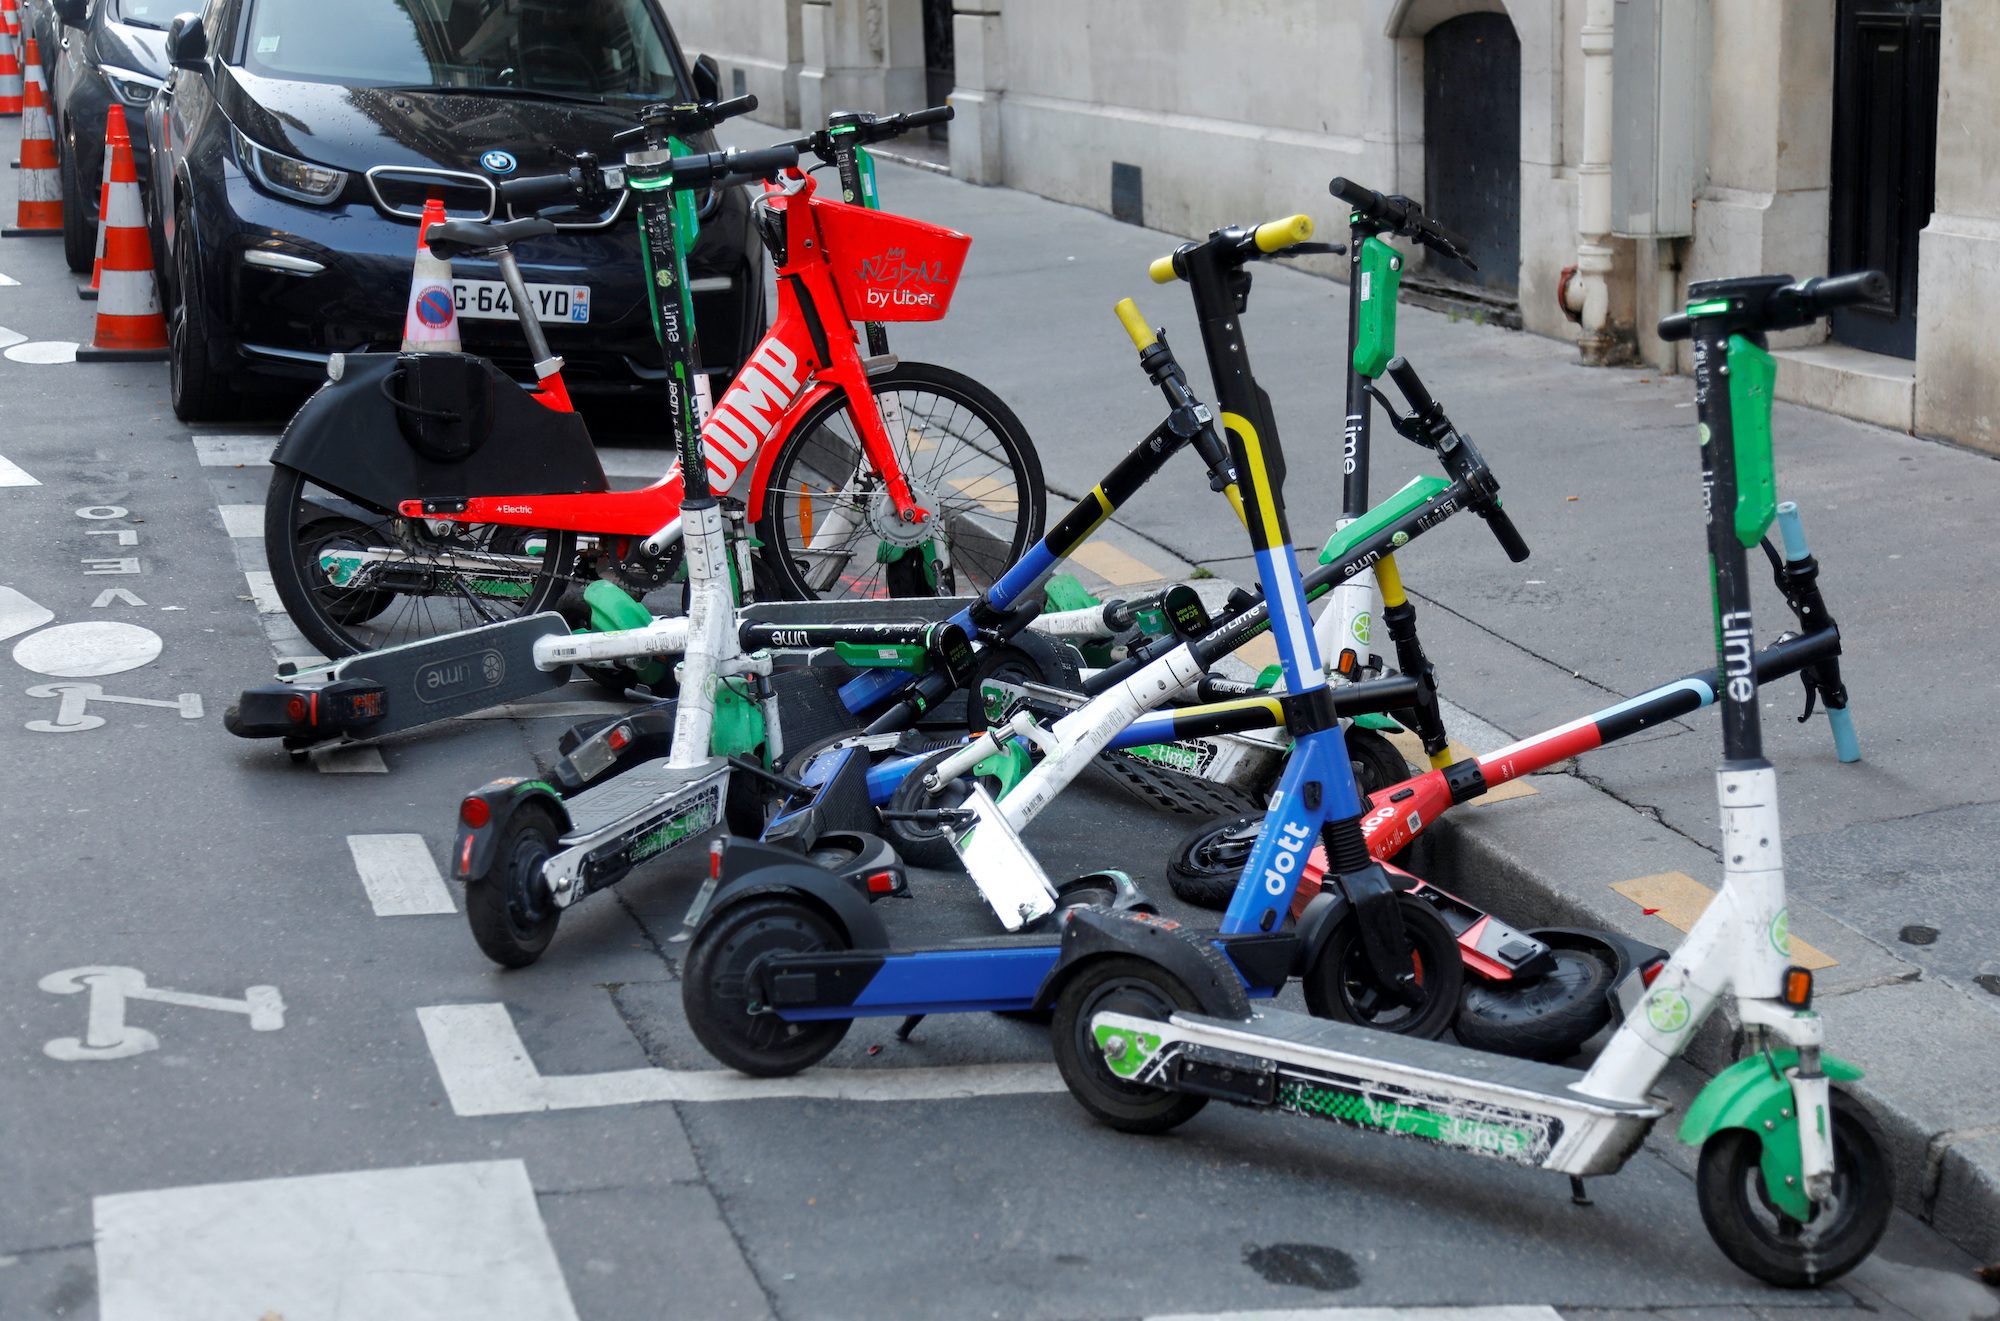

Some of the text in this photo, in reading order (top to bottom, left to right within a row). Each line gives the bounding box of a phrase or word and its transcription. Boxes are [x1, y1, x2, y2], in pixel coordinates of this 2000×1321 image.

[453, 285, 569, 316] G-64-YD
[867, 289, 935, 308] by Uber
[573, 306, 587, 320] 75
[663, 303, 680, 343] Lime
[702, 337, 801, 493] JUMP
[1343, 414, 1363, 475] Lime
[503, 504, 533, 514] Electric
[1344, 550, 1381, 577] Lime
[1178, 609, 1199, 623] SCAN
[1228, 608, 1261, 630] Lime
[771, 630, 811, 647] Lime
[1722, 611, 1753, 703] Lime
[1264, 821, 1310, 896] dott
